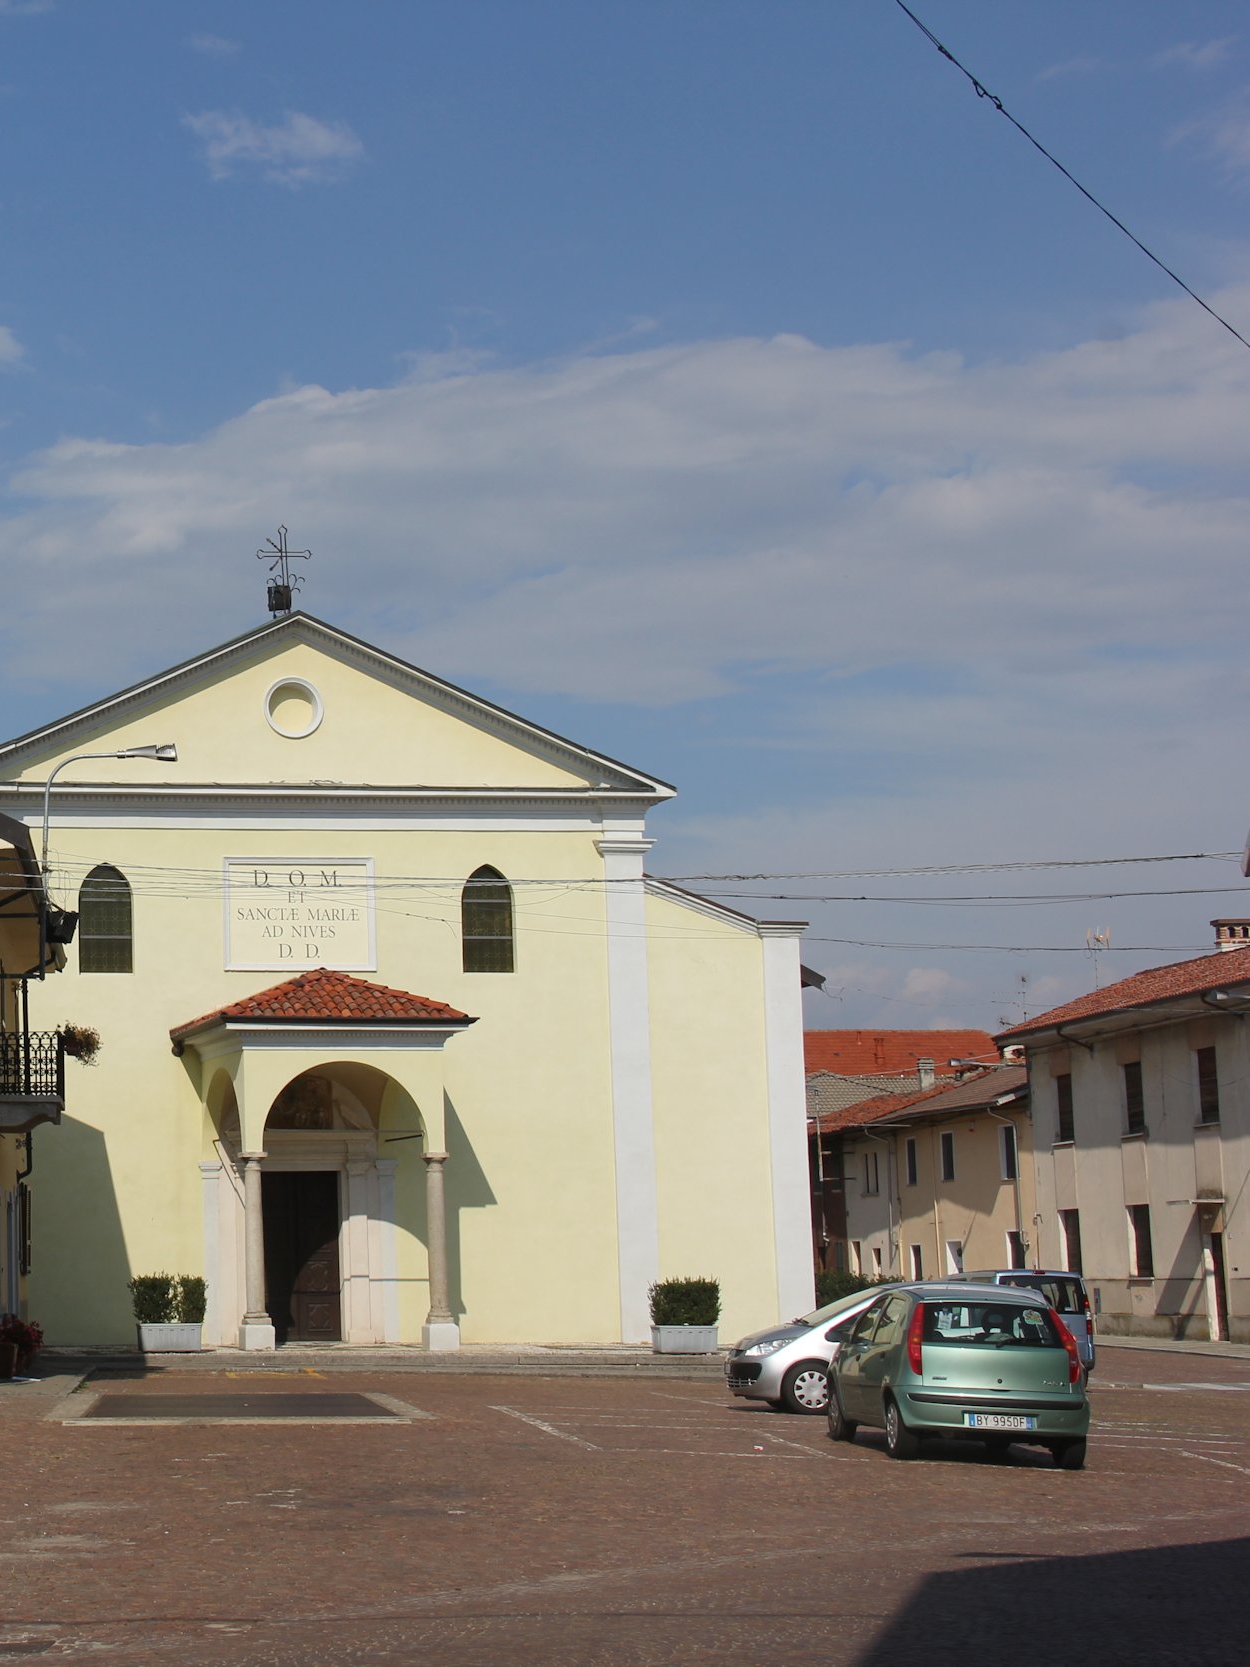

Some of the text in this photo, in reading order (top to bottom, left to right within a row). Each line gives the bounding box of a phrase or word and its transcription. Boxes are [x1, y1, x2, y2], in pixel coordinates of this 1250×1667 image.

[253, 869, 342, 887] D. O. M.
[288, 891, 307, 904] ET
[261, 925, 336, 938] AD NIVES
[279, 943, 320, 958] D. D.
[976, 1415, 1025, 1428] BY 995DF
